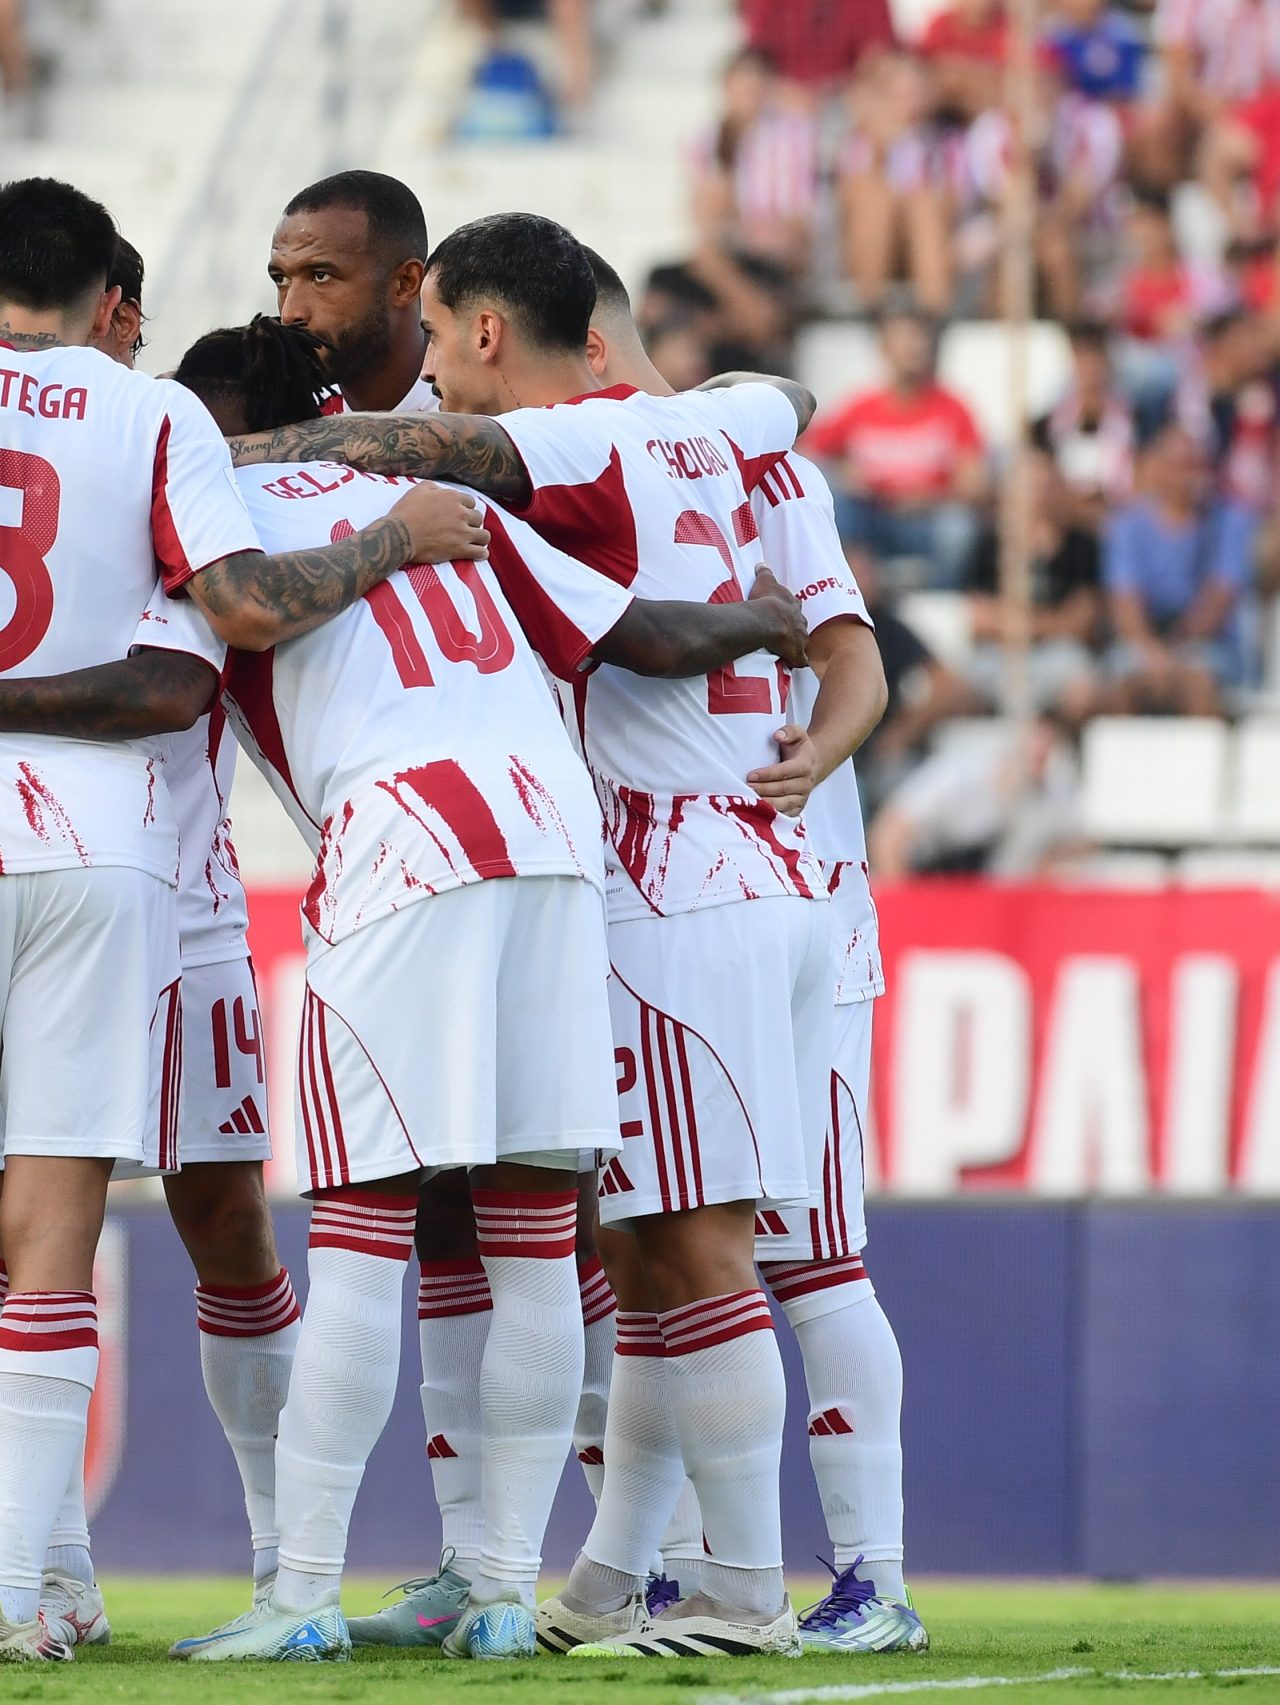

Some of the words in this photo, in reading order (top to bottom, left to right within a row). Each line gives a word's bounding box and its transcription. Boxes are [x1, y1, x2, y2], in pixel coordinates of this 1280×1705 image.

[331, 519, 515, 688] 10
[674, 501, 791, 714] 2
[211, 996, 263, 1088] 14
